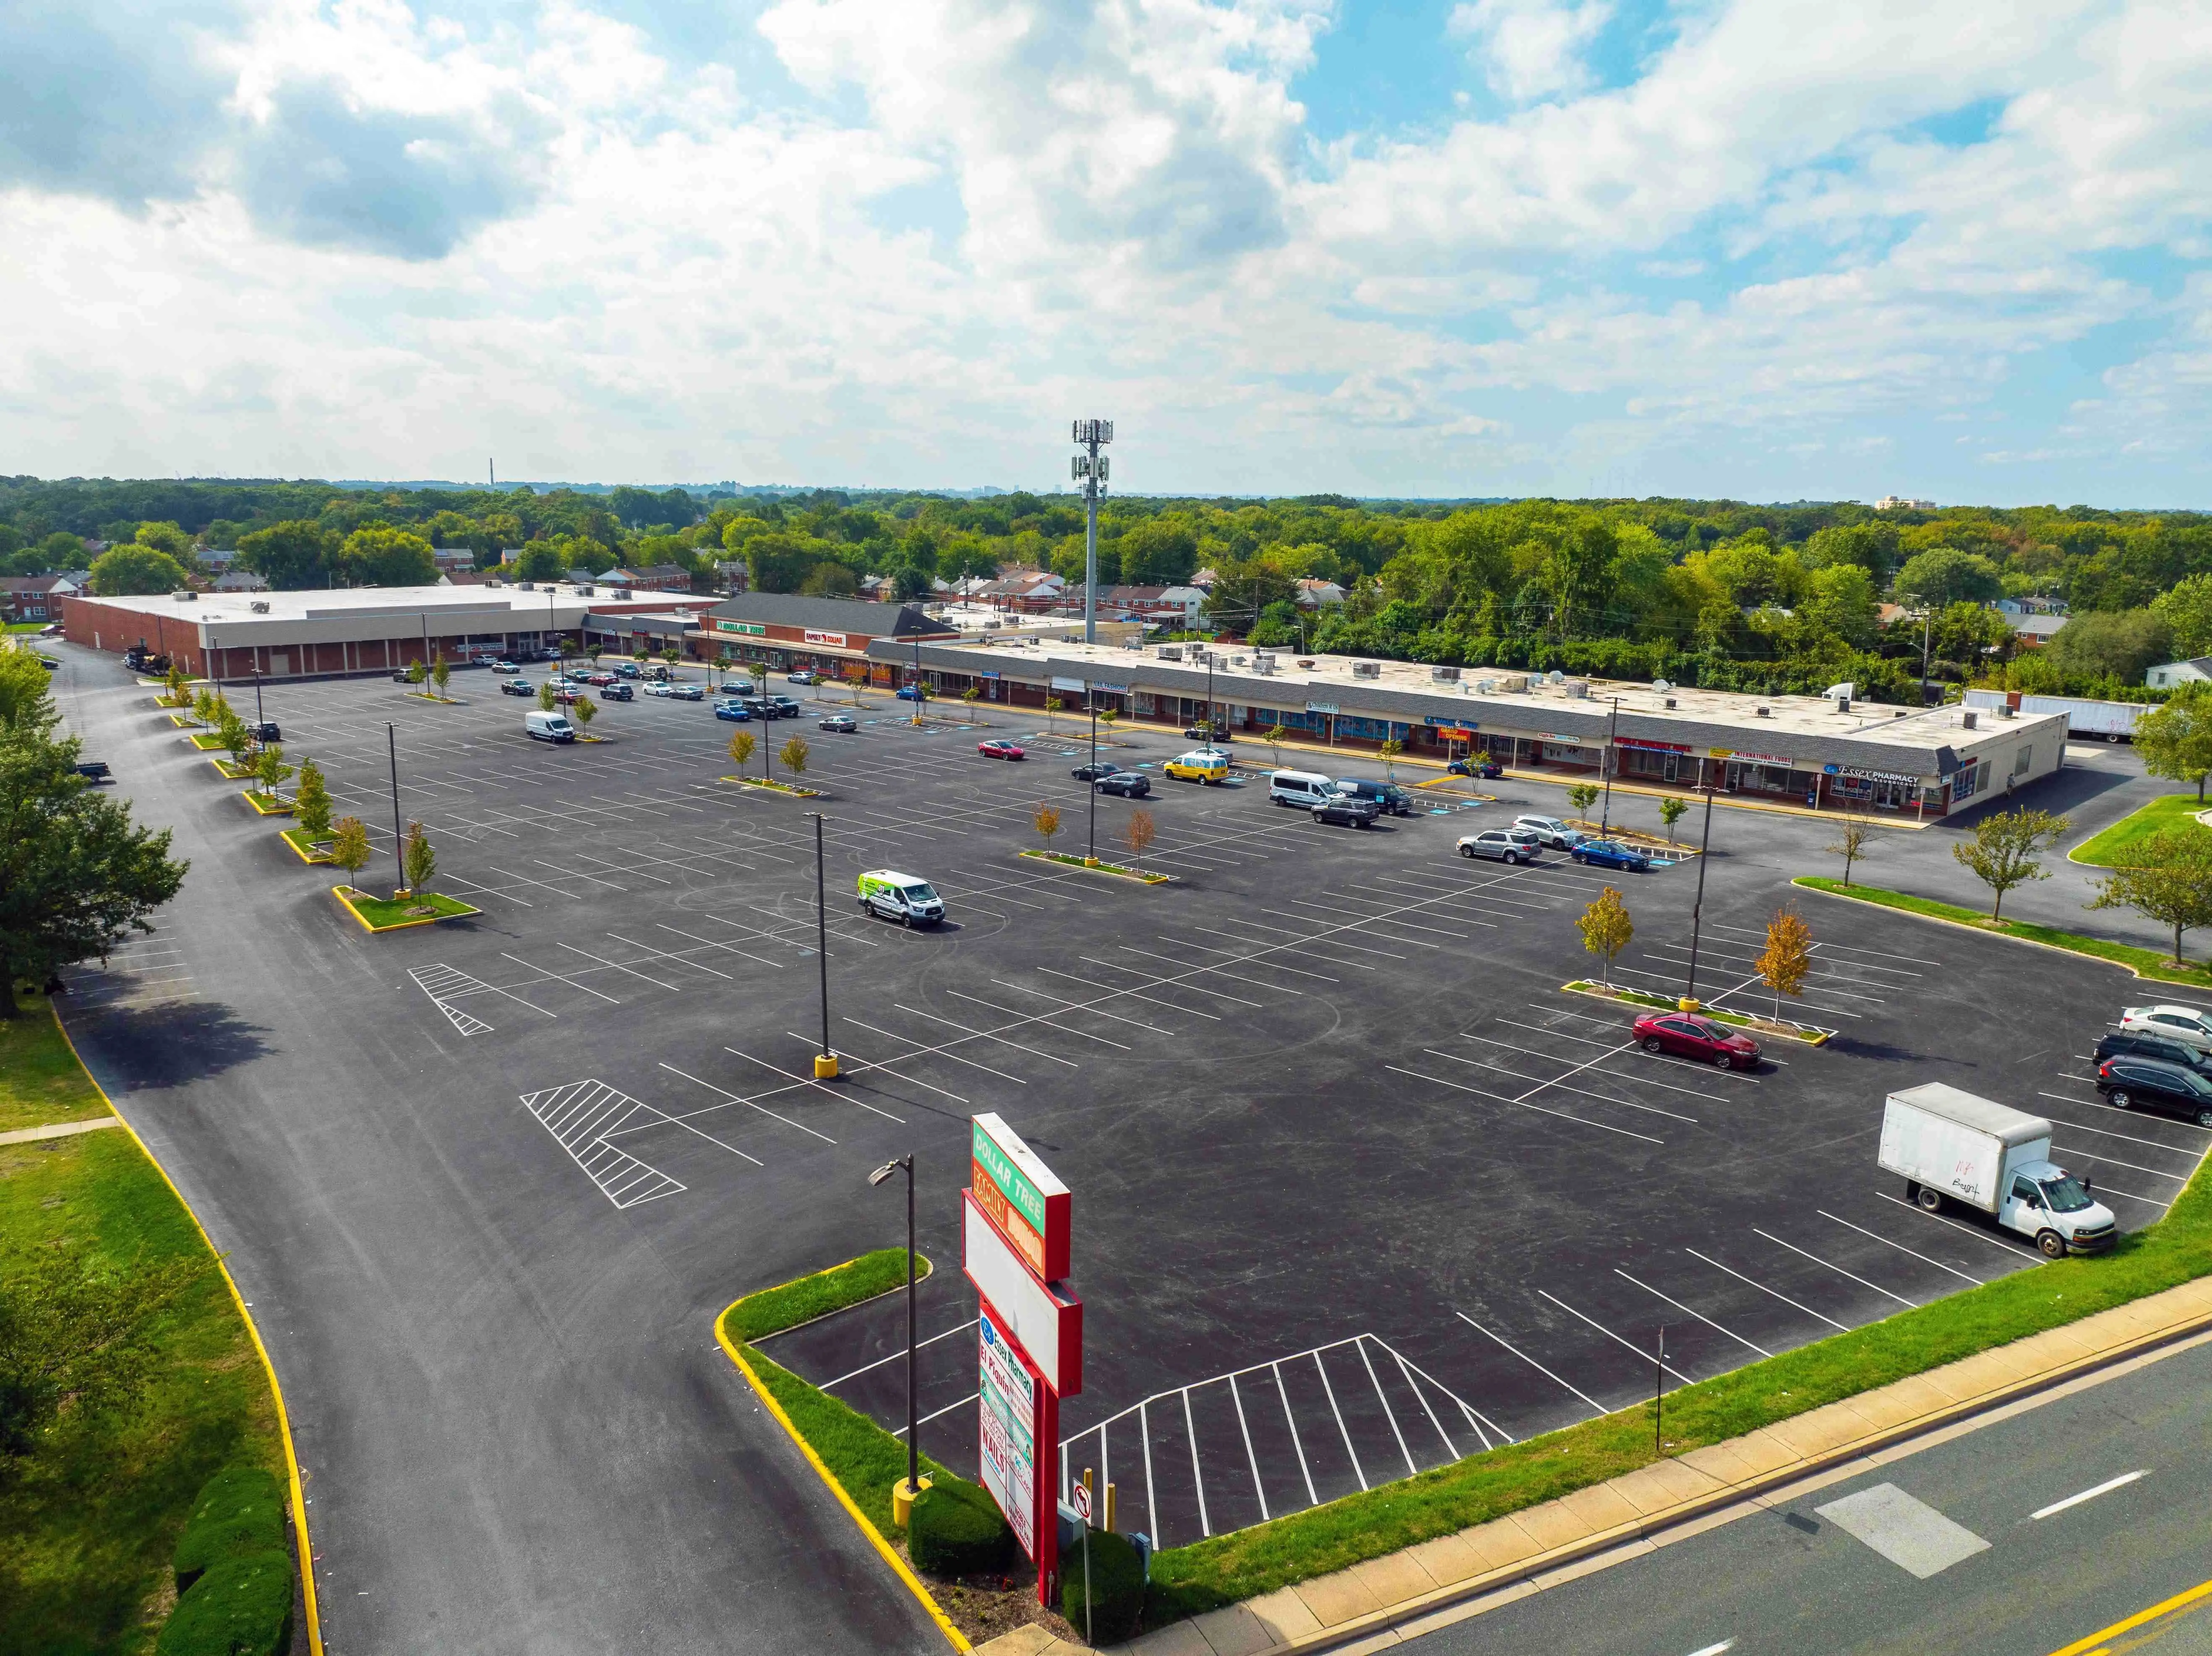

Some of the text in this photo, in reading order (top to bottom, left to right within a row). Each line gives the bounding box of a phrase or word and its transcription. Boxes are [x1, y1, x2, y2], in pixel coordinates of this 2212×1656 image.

[723, 623, 764, 634] DOLLAR TREE
[828, 636, 842, 644] DOLLAR
[1104, 682, 1127, 690] FASHIONS
[1735, 751, 1773, 761] INTERNATIONAL
[1839, 766, 1919, 783] Essex PHARMACY
[976, 1133, 1041, 1221] DOLLAR TREE
[975, 1166, 1006, 1223] FAMILY
[981, 1344, 986, 1364] El
[989, 1355, 1009, 1396] Piquin
[994, 1331, 1032, 1401] Essex Pharmacy
[1017, 1404, 1033, 1432] MARKET
[983, 1427, 1004, 1474] NAILS
[985, 1447, 1000, 1477] Fashions
[1008, 1503, 1032, 1549] BANQUET HALL
[1015, 1505, 1026, 1529] NOBLE
